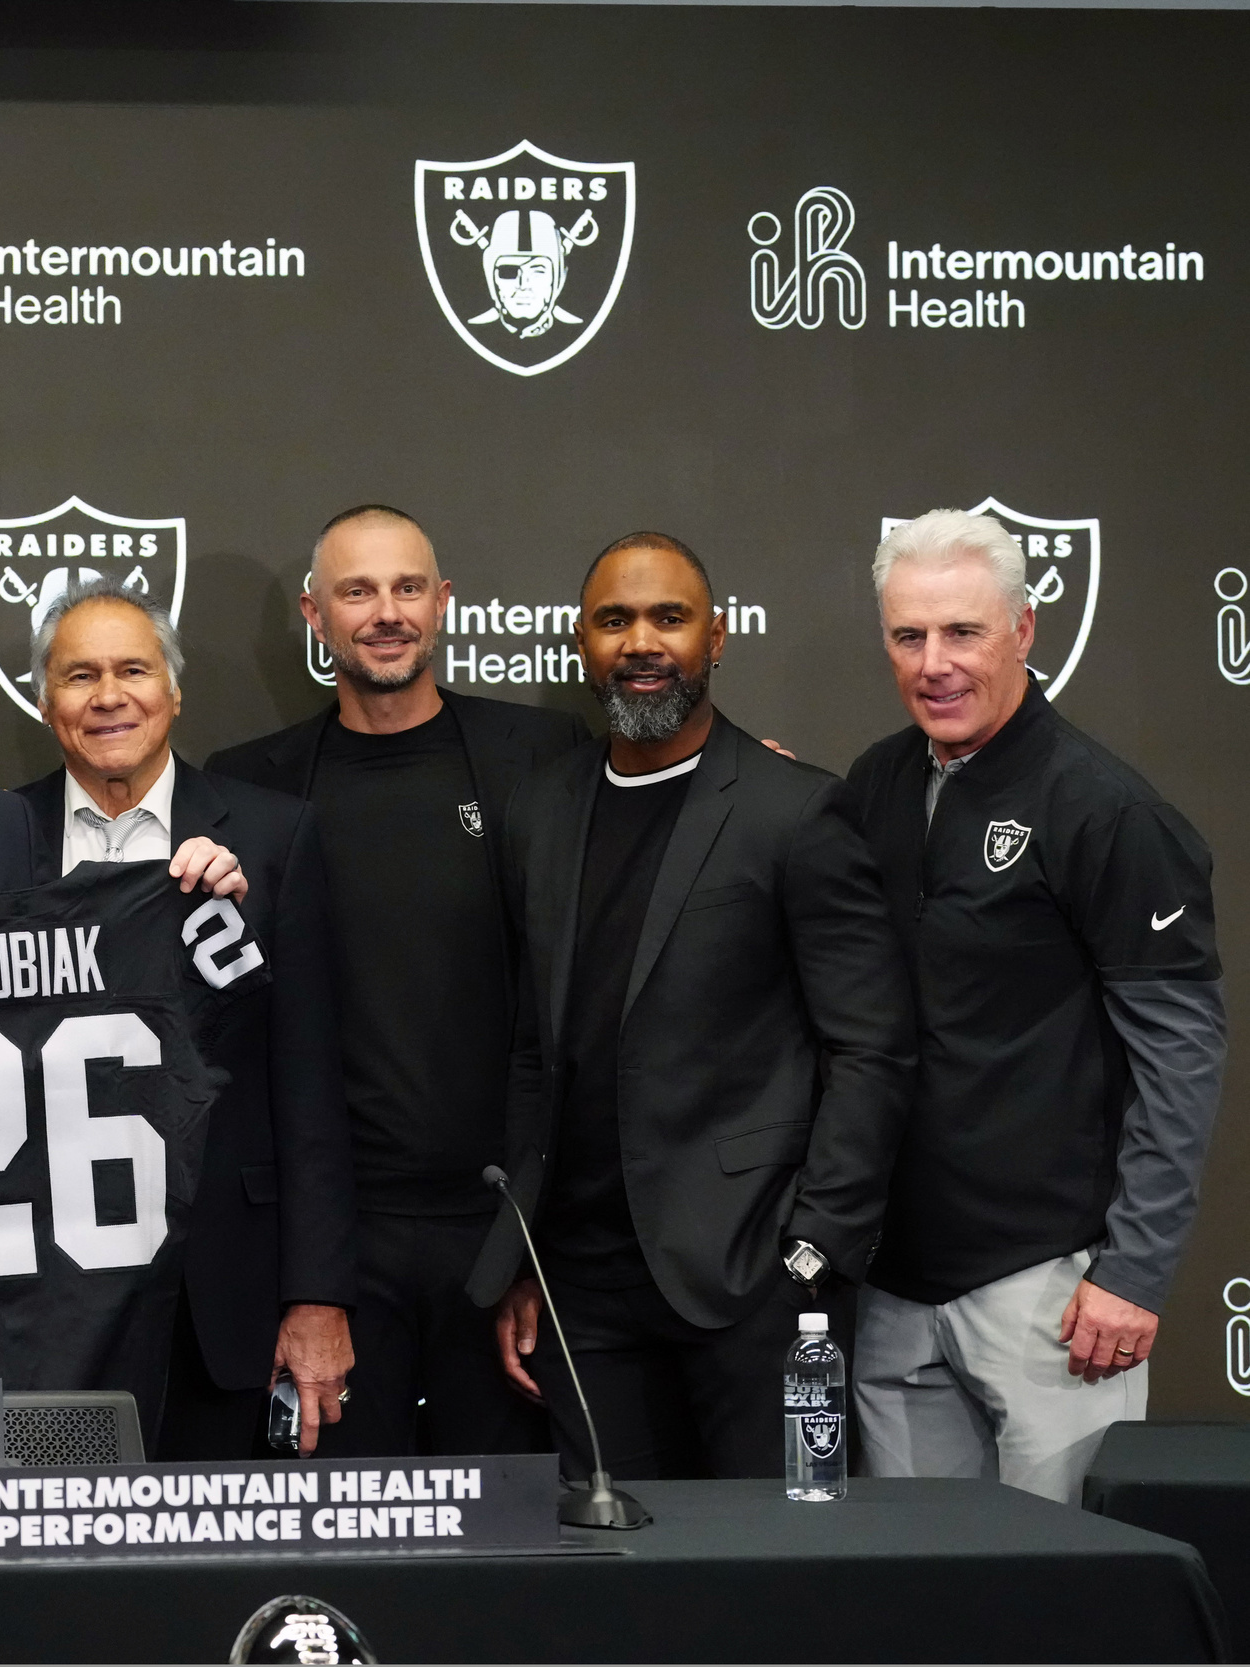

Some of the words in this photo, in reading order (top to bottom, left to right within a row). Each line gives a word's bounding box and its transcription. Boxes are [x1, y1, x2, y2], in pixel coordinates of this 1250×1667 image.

[445, 176, 608, 202] RAIDERS
[888, 240, 1204, 281] Intermountain
[888, 289, 1025, 329] Health
[447, 644, 585, 684] Health
[993, 827, 1025, 837] RAIDERS
[330, 1468, 481, 1503] HEALTH
[311, 1505, 464, 1540] CENTER
